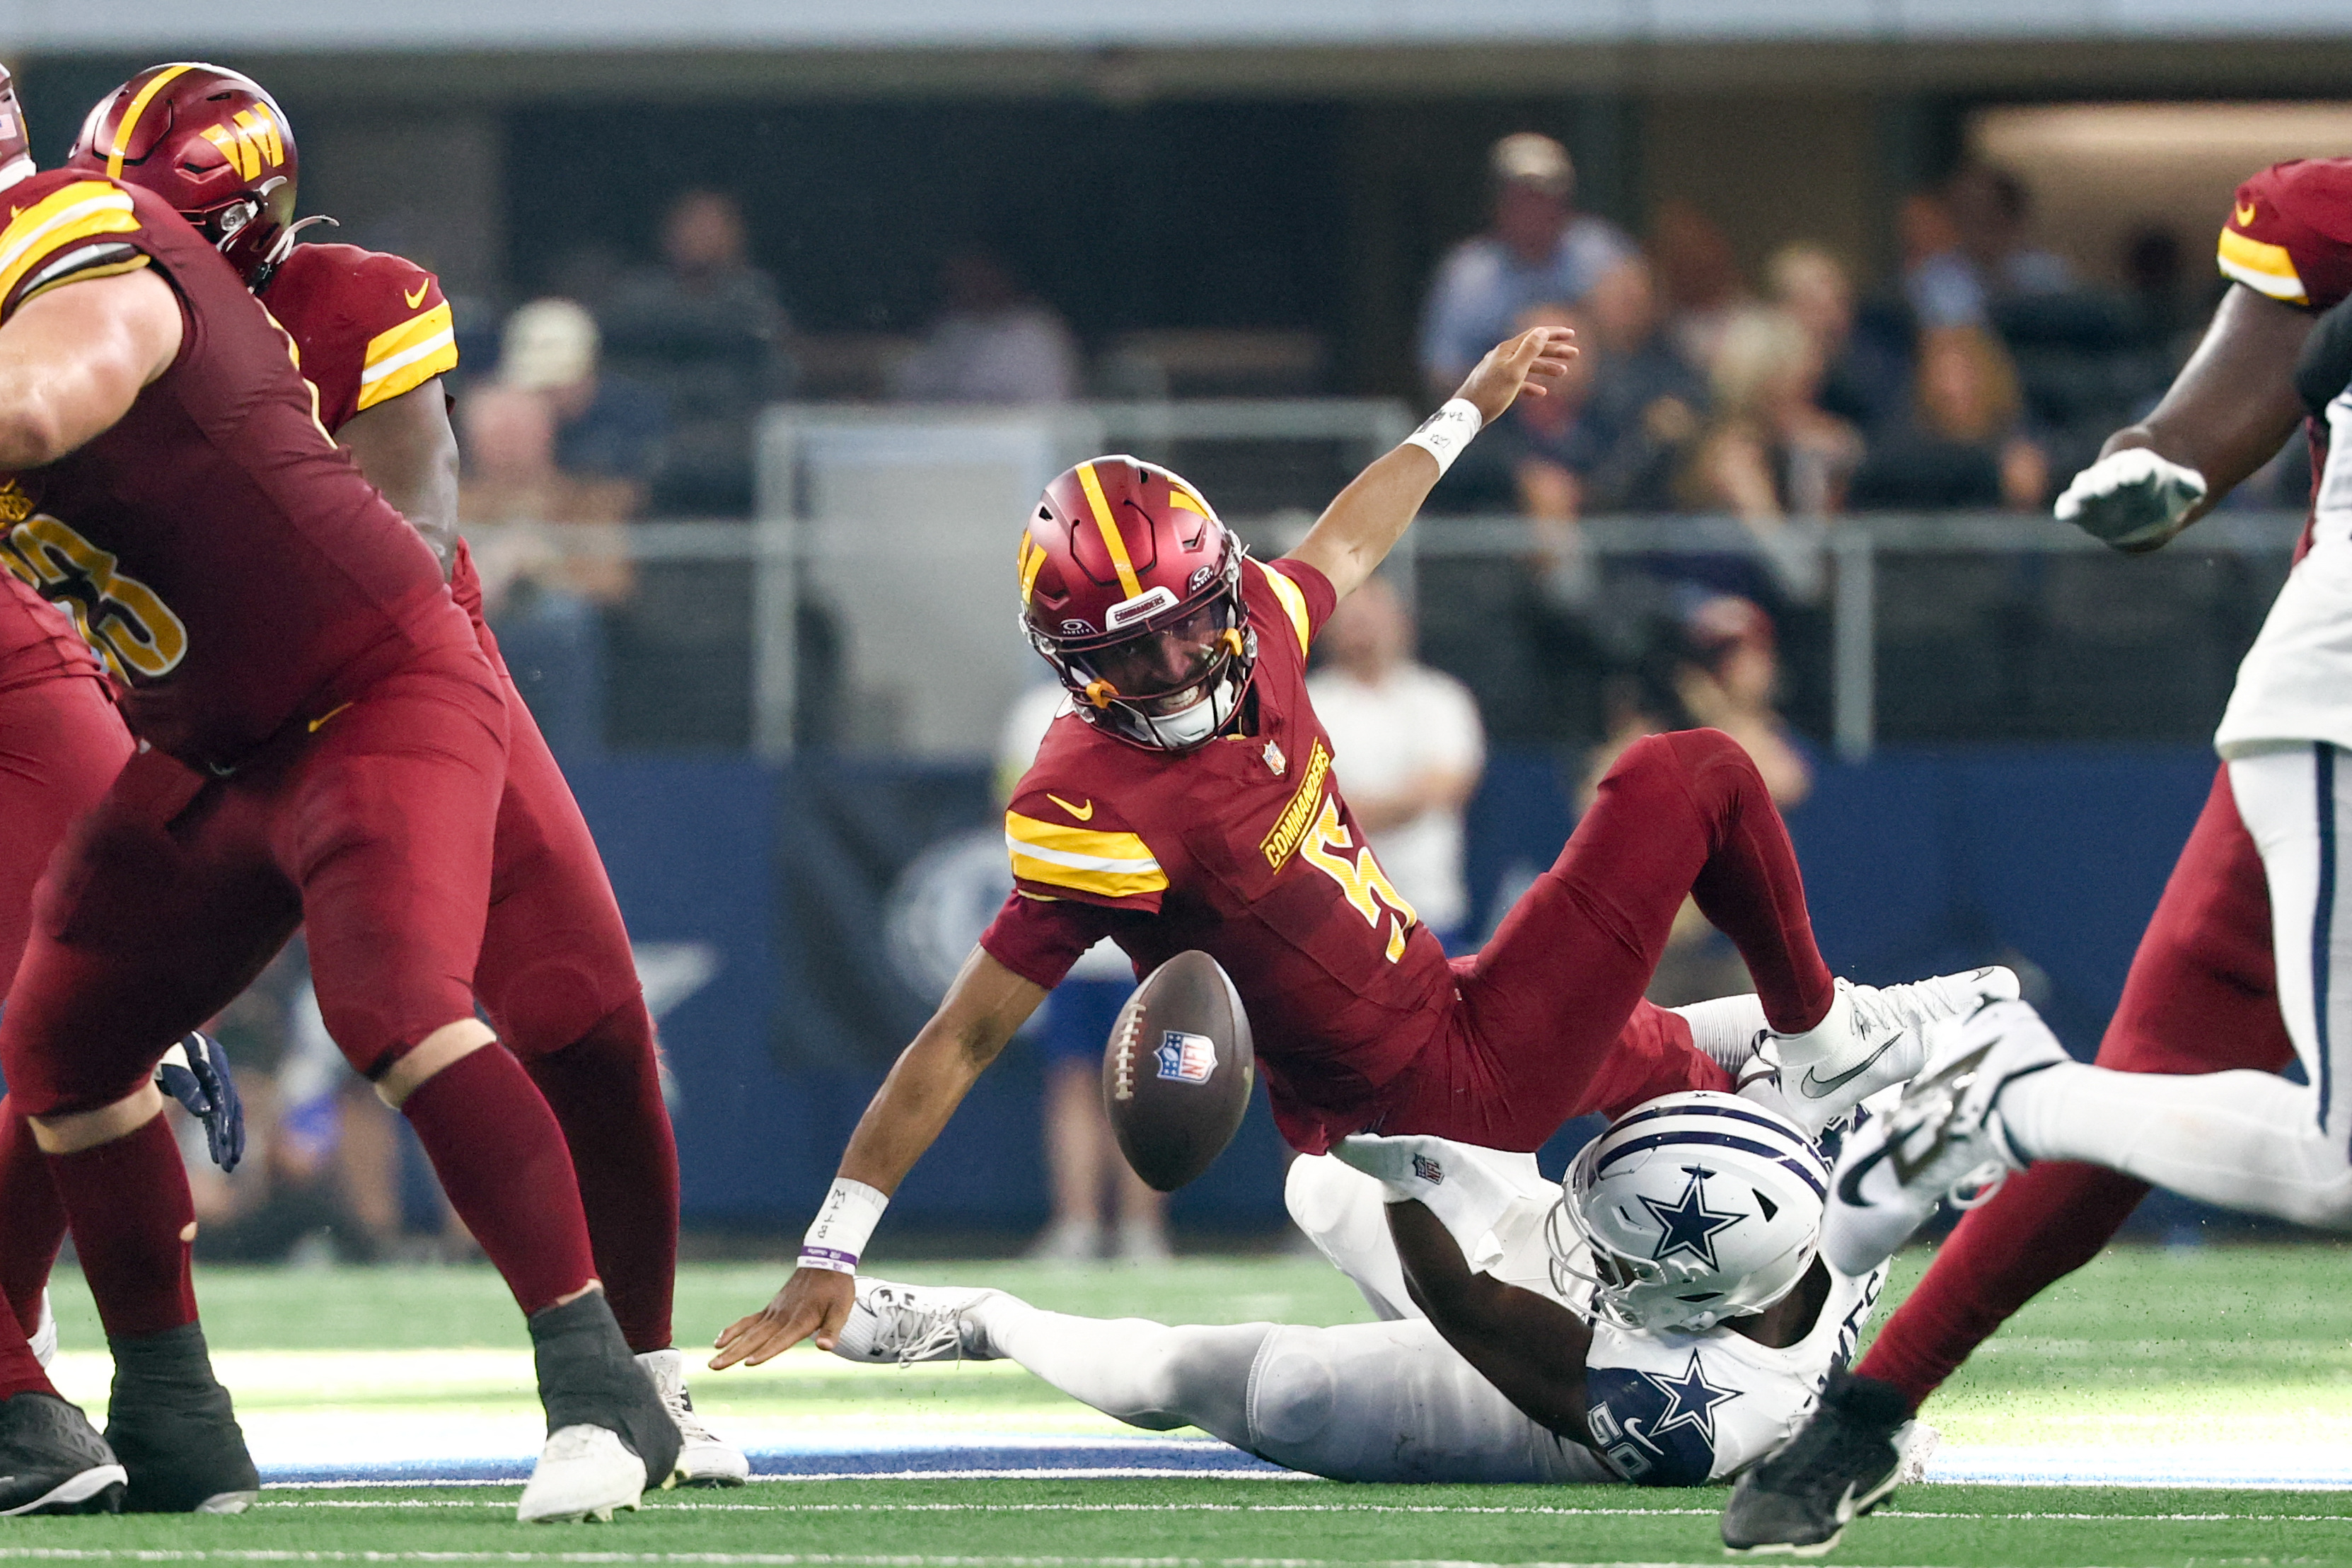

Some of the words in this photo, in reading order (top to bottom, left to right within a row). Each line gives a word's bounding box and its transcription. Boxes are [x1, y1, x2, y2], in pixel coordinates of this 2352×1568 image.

[1191, 571, 1214, 591] OAKLEY
[1114, 595, 1166, 622] COMMANDERS
[1264, 743, 1331, 869] COMMANDERS
[1299, 792, 1418, 964] 5
[1182, 1044, 1207, 1076] NFL
[1427, 1161, 1441, 1182] NFL
[1587, 1400, 1652, 1480] 50
